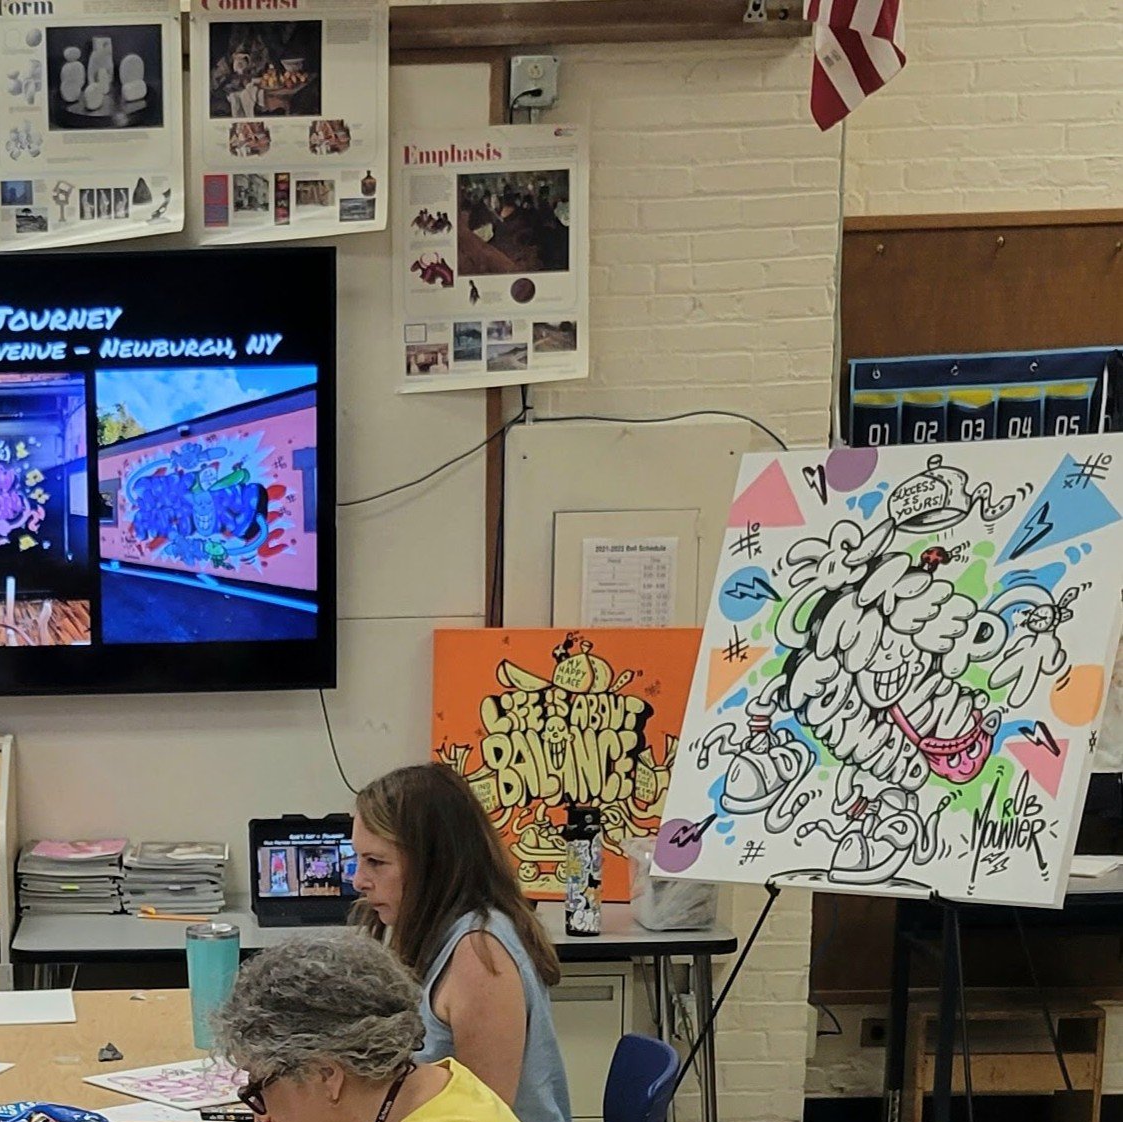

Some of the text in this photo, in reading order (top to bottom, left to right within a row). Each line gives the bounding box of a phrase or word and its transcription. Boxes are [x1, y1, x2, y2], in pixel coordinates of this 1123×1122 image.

[403, 143, 502, 167] Emphasis
[100, 336, 238, 360] NEWBURGH,
[245, 333, 283, 355] NY
[868, 415, 1081, 446] 01 02 03 04 05
[892, 480, 937, 503] SUCCESS
[903, 494, 919, 507] IS
[896, 493, 944, 520] YOURS!
[558, 665, 587, 679] HAPPY
[567, 660, 582, 669] MY
[554, 674, 582, 689] PLACE
[480, 688, 648, 735] LIFE IS ABOUT
